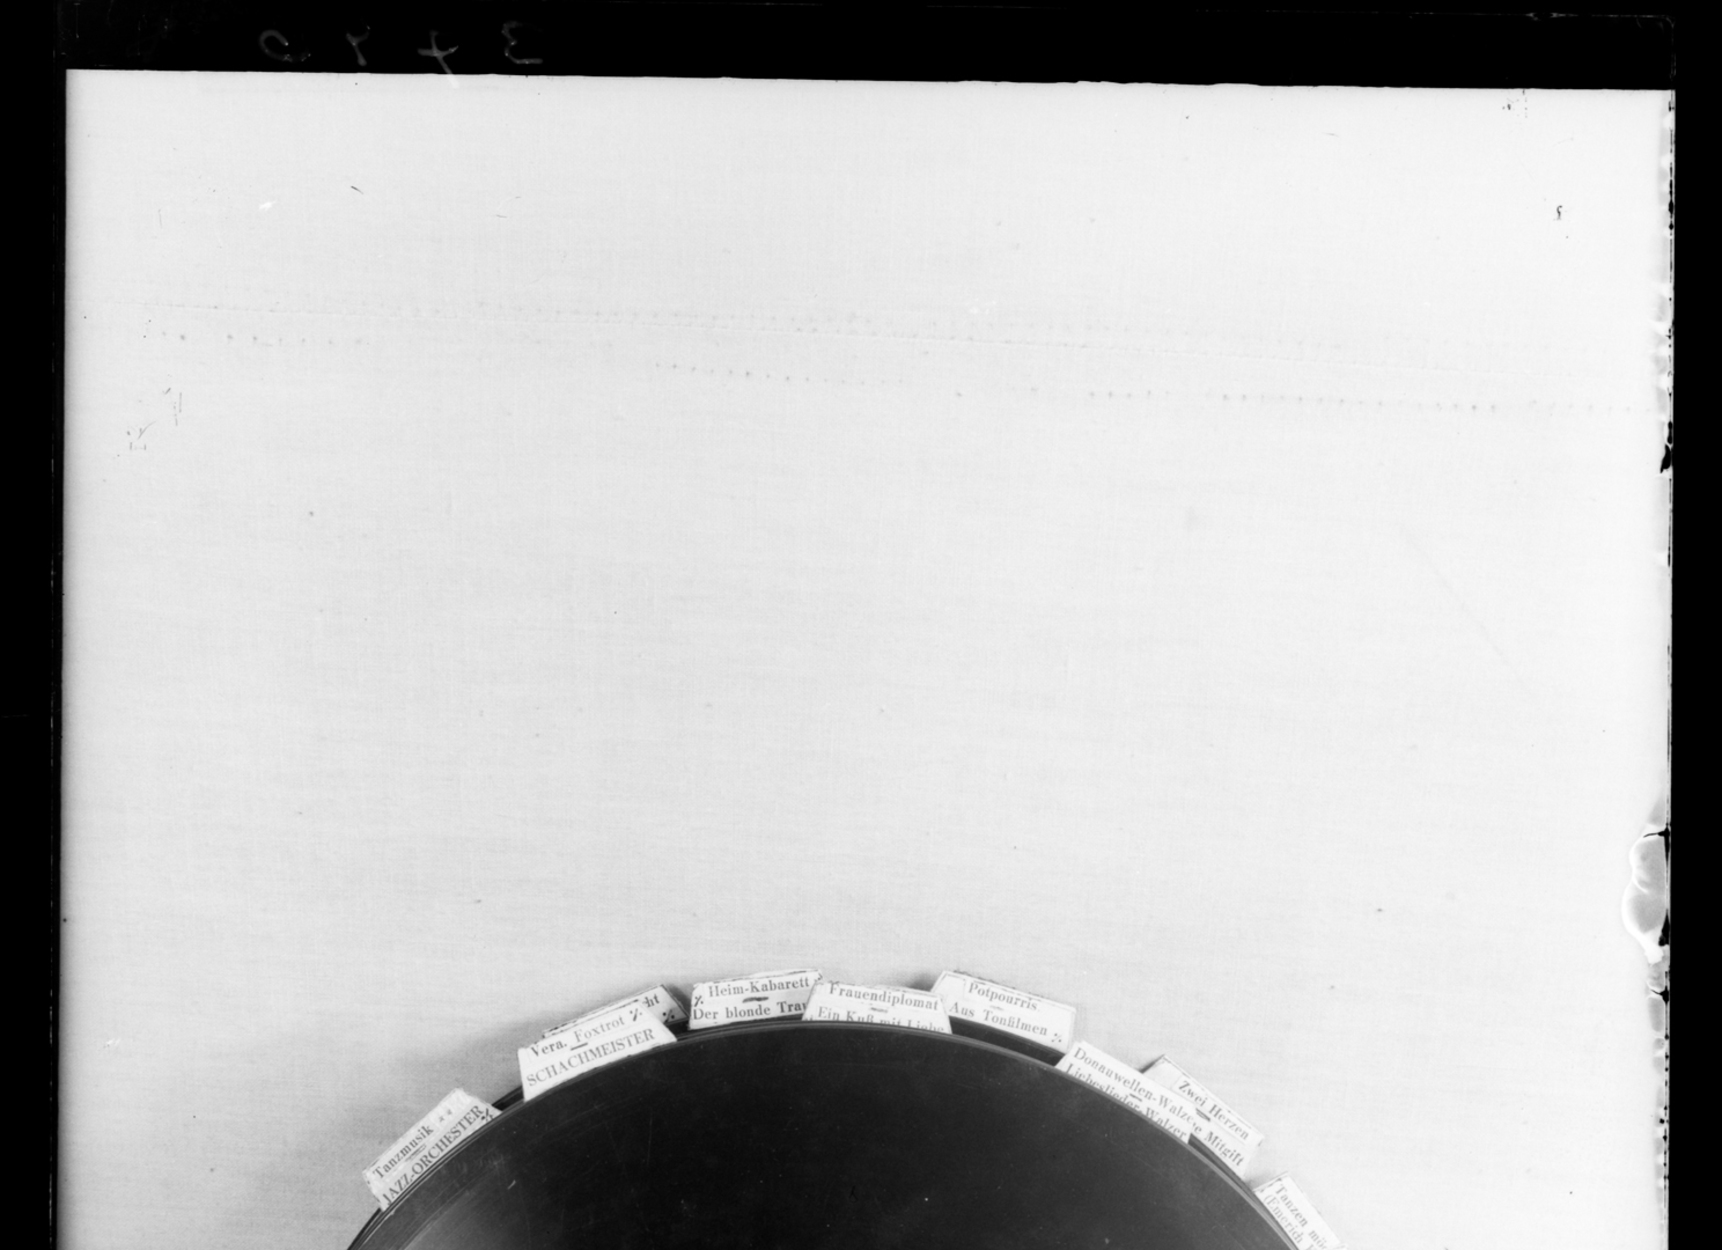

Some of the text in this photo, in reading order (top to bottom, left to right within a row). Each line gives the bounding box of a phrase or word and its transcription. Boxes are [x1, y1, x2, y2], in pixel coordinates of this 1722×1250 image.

[708, 975, 810, 998] Heim-Kabarett
[828, 984, 939, 1010] Frauendiplomat
[968, 982, 1038, 1011] Potpourris
[692, 1006, 719, 1020] Der
[726, 1001, 771, 1018] blonde
[818, 1006, 840, 1020] Ein
[949, 1002, 1048, 1036] Aus Tonfilmen
[530, 1015, 626, 1058] Vera. Foxtrot
[526, 1027, 656, 1088] SCHACHMEISTER
[1178, 1080, 1250, 1140] Zwei Herzen
[372, 1124, 434, 1180] Tanzmusik
[382, 1104, 485, 1206] JAZZ-ORCHESTER
[1204, 1131, 1245, 1167] Mitgift
[1275, 1183, 1308, 1227] Tanzen
